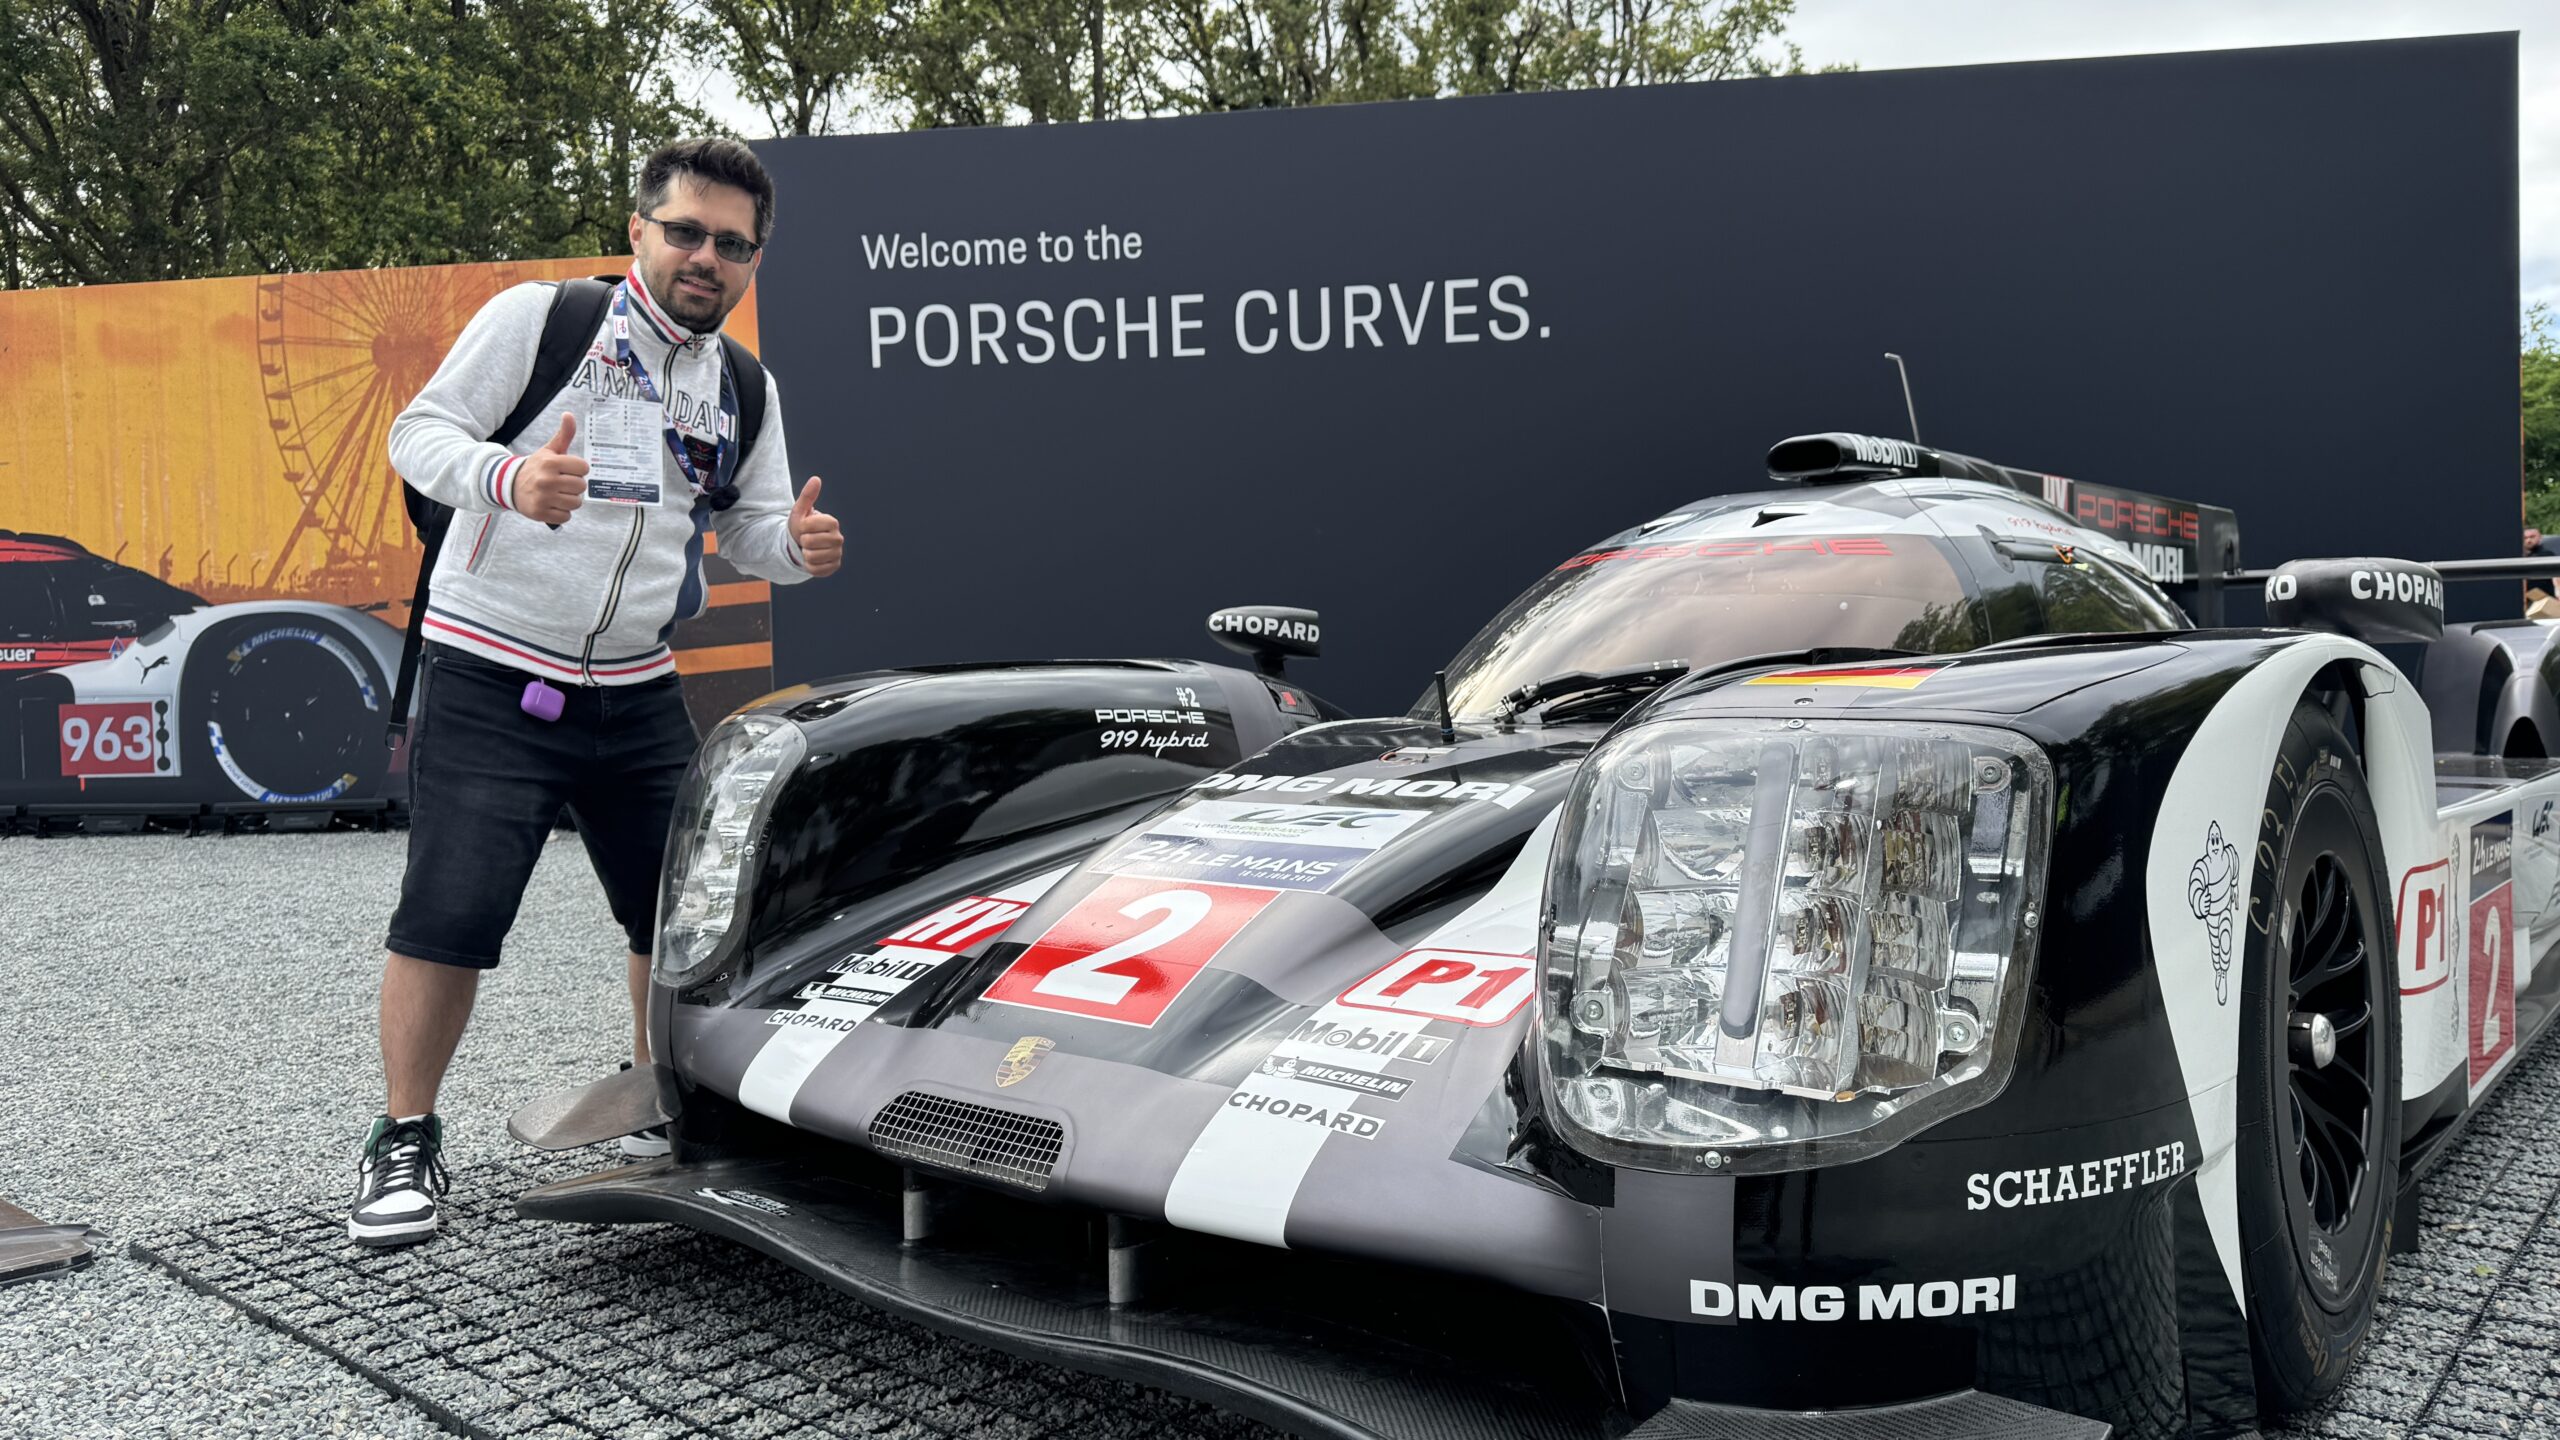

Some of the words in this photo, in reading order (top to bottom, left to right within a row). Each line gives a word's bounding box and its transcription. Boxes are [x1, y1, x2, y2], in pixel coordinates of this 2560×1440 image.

[861, 232, 1027, 270] Welcome
[1037, 231, 1074, 263] to
[1084, 224, 1143, 261] the
[868, 293, 1206, 369] PORSCHE
[1235, 275, 1552, 355] CURVES.
[1853, 434, 1902, 466] Mobil
[2078, 493, 2200, 539] PORSCHE
[1557, 538, 1893, 571] ORSCHE
[2351, 570, 2443, 610] CHOPAR
[251, 627, 318, 647] MICHELIN
[1208, 614, 1320, 643] CHOPARD
[1176, 687, 1200, 708] #2
[1095, 709, 1206, 725] PORSCHE
[62, 716, 152, 762] 963
[1100, 730, 1140, 749] 919
[1141, 729, 1209, 758] hybrid
[1328, 777, 1536, 810] MORI
[1187, 852, 1239, 867] LE
[1231, 855, 1339, 875] MANS
[887, 898, 1032, 946] HY
[2415, 884, 2446, 971] P1
[1033, 889, 1213, 1005] 2
[831, 955, 911, 978] Mobil
[1377, 959, 1531, 1009] P1
[2482, 905, 2502, 1057] 2
[824, 987, 890, 1003] MICHELIN
[769, 1011, 858, 1032] CHOPARD
[1288, 1019, 1410, 1056] Mobil
[1300, 1065, 1411, 1095] MICHELIN
[1228, 1092, 1380, 1138] CHOPARD
[1967, 1141, 2185, 1211] SCHAEFFLER
[1690, 1279, 1845, 1321] DMG
[1858, 1274, 2016, 1320] MORI
